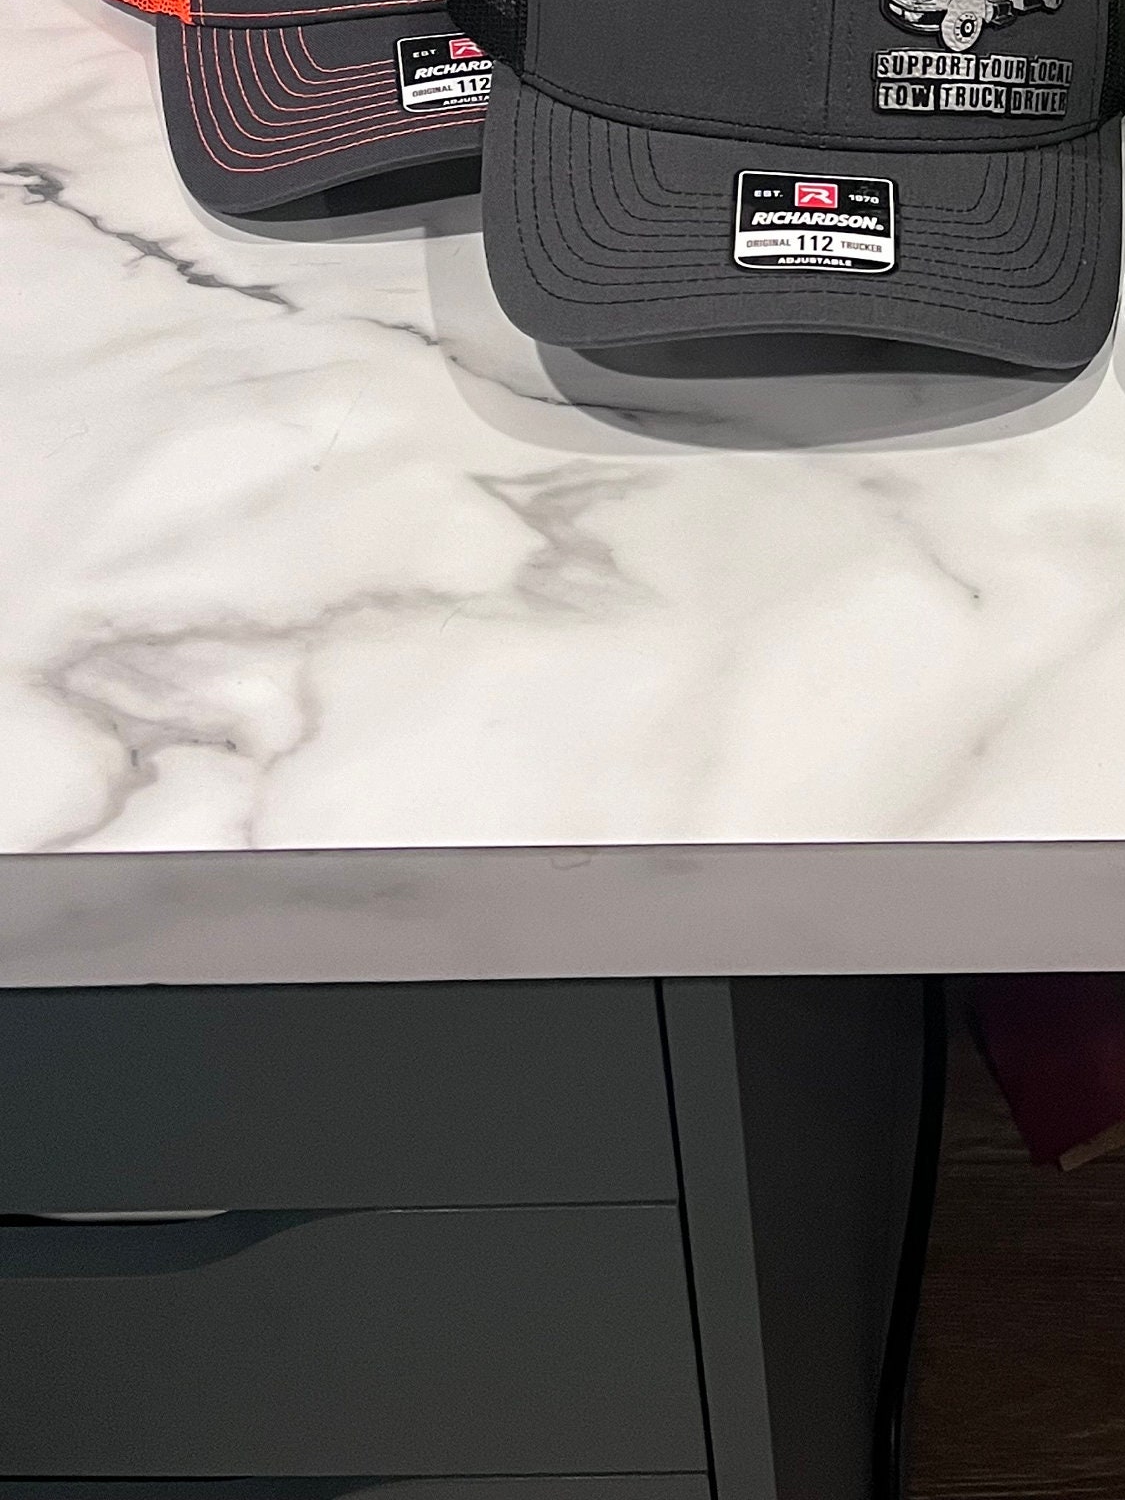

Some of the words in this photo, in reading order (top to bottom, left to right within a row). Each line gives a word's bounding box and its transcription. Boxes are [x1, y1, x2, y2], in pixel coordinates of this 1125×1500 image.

[414, 60, 493, 79] RICHARD
[878, 55, 974, 76] SUPPORT
[980, 58, 1025, 79] YOUR
[1030, 62, 1071, 84] LOCAL
[413, 85, 453, 97] ORIGINAL
[457, 78, 490, 92] 112
[881, 85, 930, 107] TOW
[942, 87, 1005, 109] TRUCK
[1013, 90, 1066, 111] DRIVER
[848, 194, 879, 203] 1970
[752, 211, 877, 230] RICHARDSON
[747, 239, 791, 248] ORIGINAL
[797, 235, 834, 252] 112
[841, 241, 882, 253] TRUCKER
[778, 257, 852, 266] ADJUSTABLE
